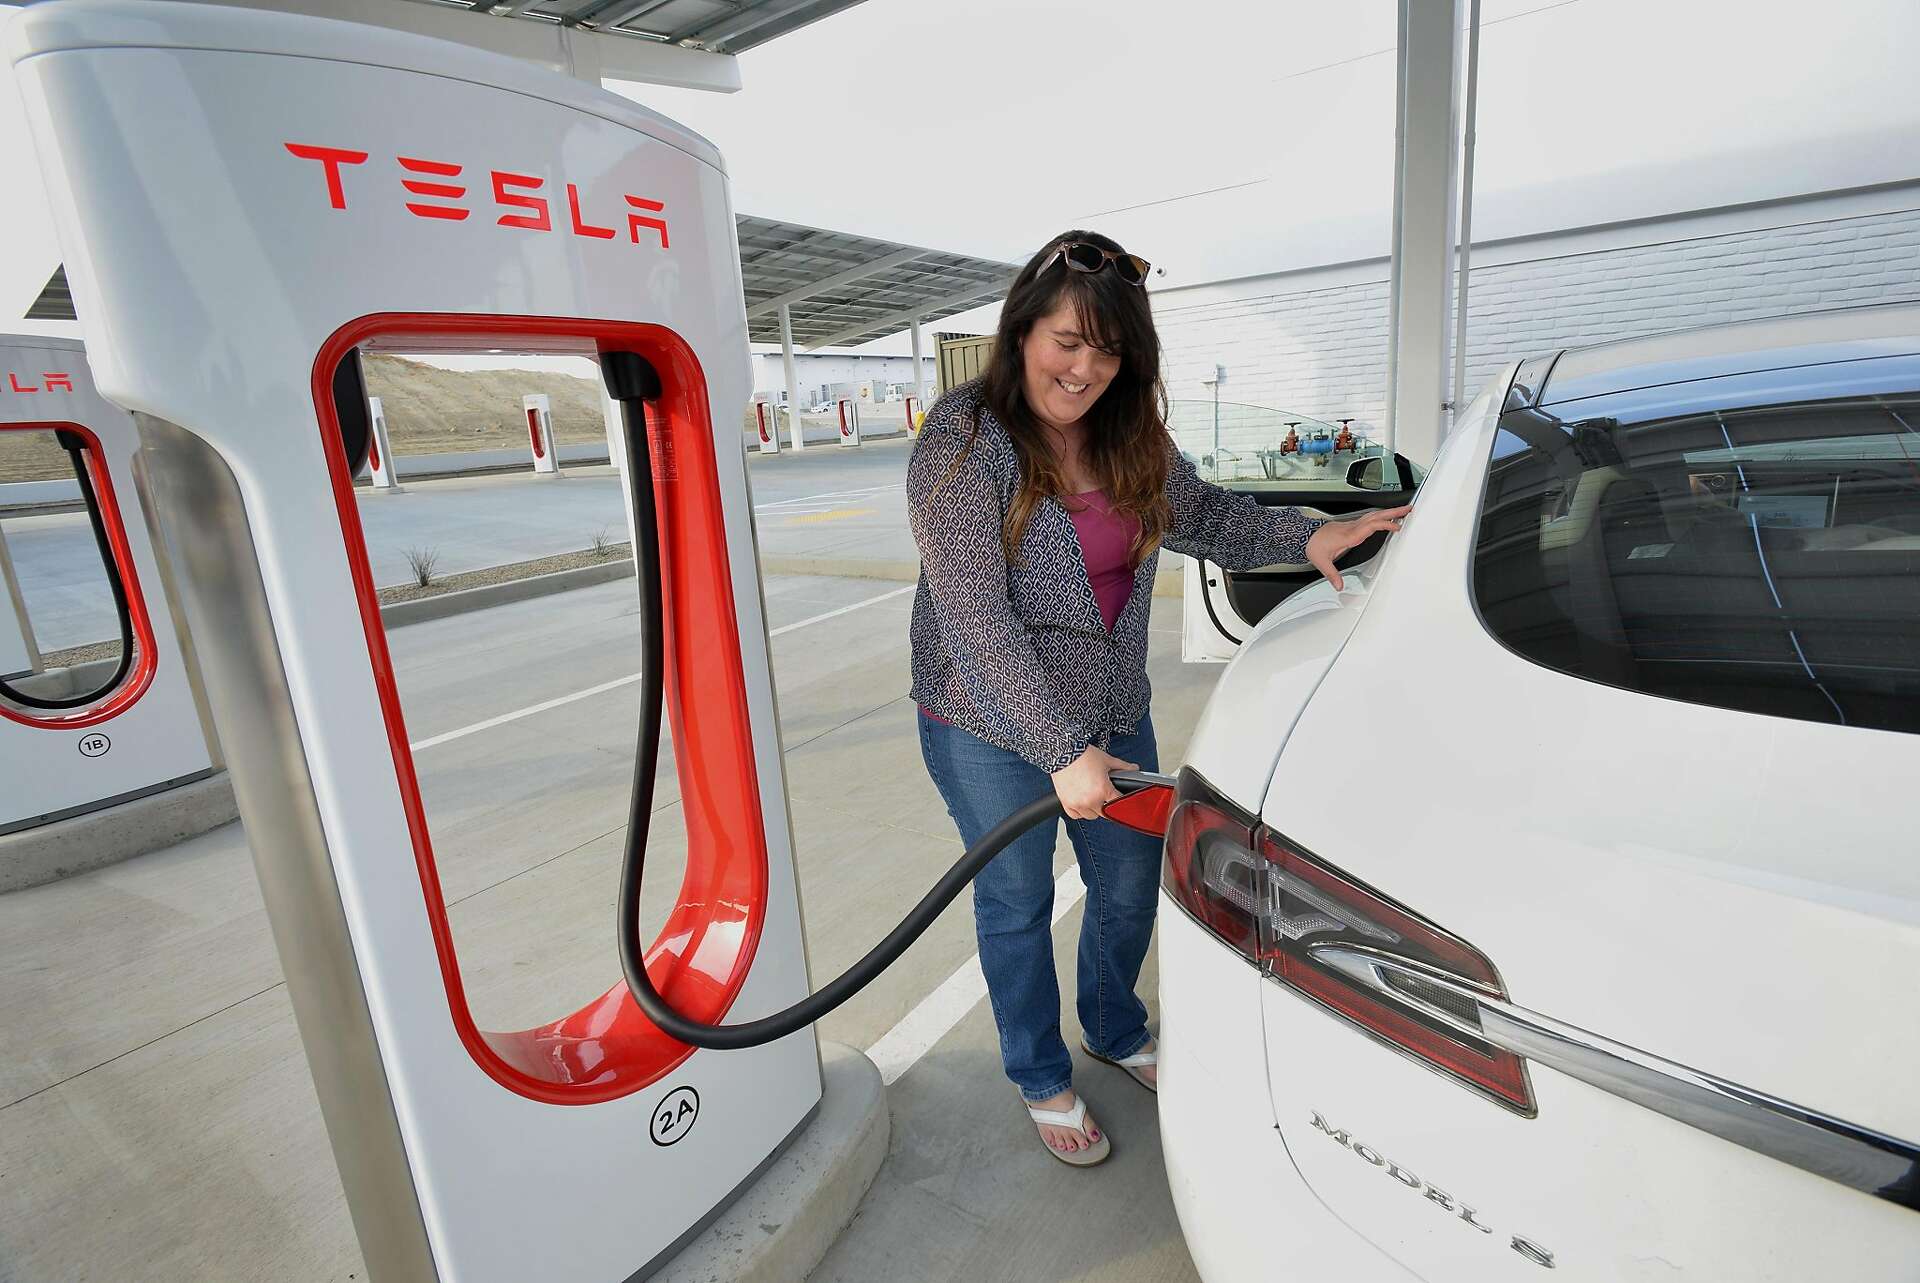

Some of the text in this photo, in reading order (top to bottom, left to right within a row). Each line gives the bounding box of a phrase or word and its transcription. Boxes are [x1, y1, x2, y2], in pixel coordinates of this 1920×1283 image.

[283, 142, 670, 249] TESLA
[0, 372, 73, 393] LA
[84, 739, 104, 751] 1B
[659, 1098, 695, 1135] 2A
[1309, 1109, 1556, 1269] MODEL S
